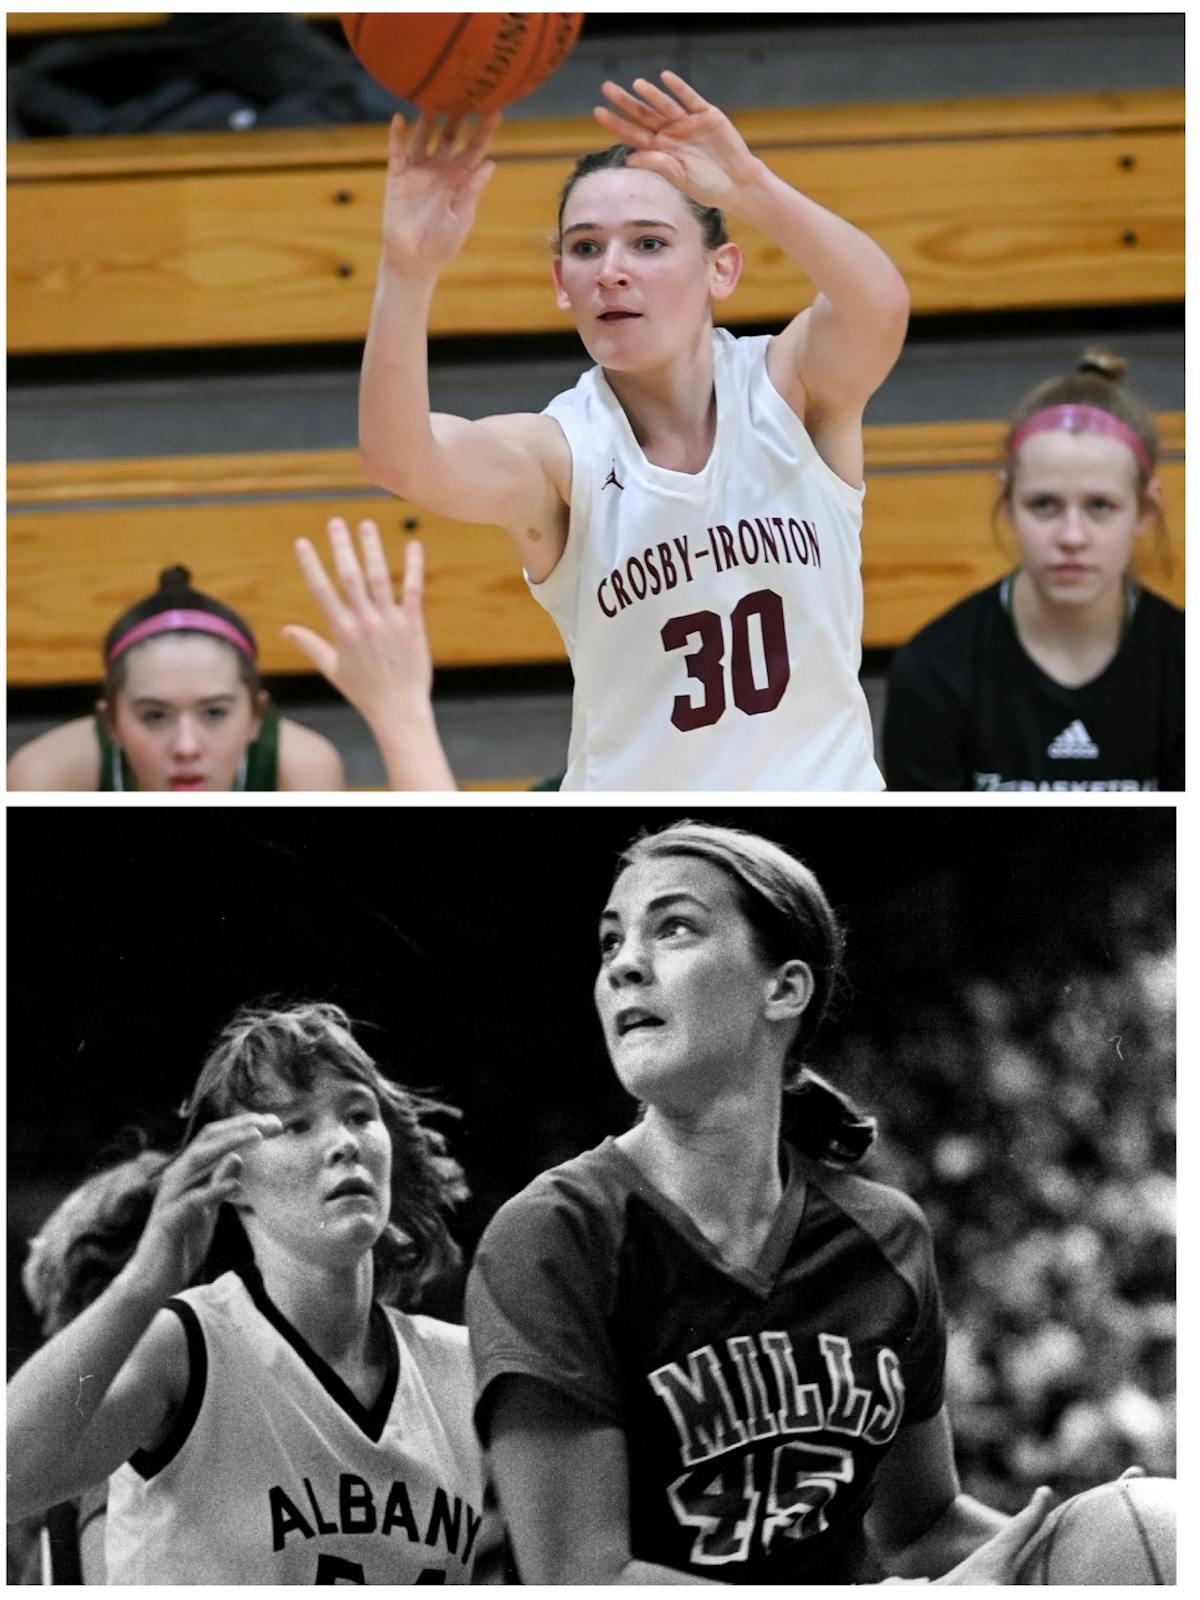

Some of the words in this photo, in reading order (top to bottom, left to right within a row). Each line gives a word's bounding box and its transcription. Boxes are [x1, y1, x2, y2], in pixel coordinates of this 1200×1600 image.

[597, 517, 822, 619] CROSBY-IRONTON
[660, 588, 791, 733] 30
[647, 1330, 906, 1468] MILLS
[268, 1473, 483, 1565] ALBANY
[665, 1440, 855, 1566] 45
